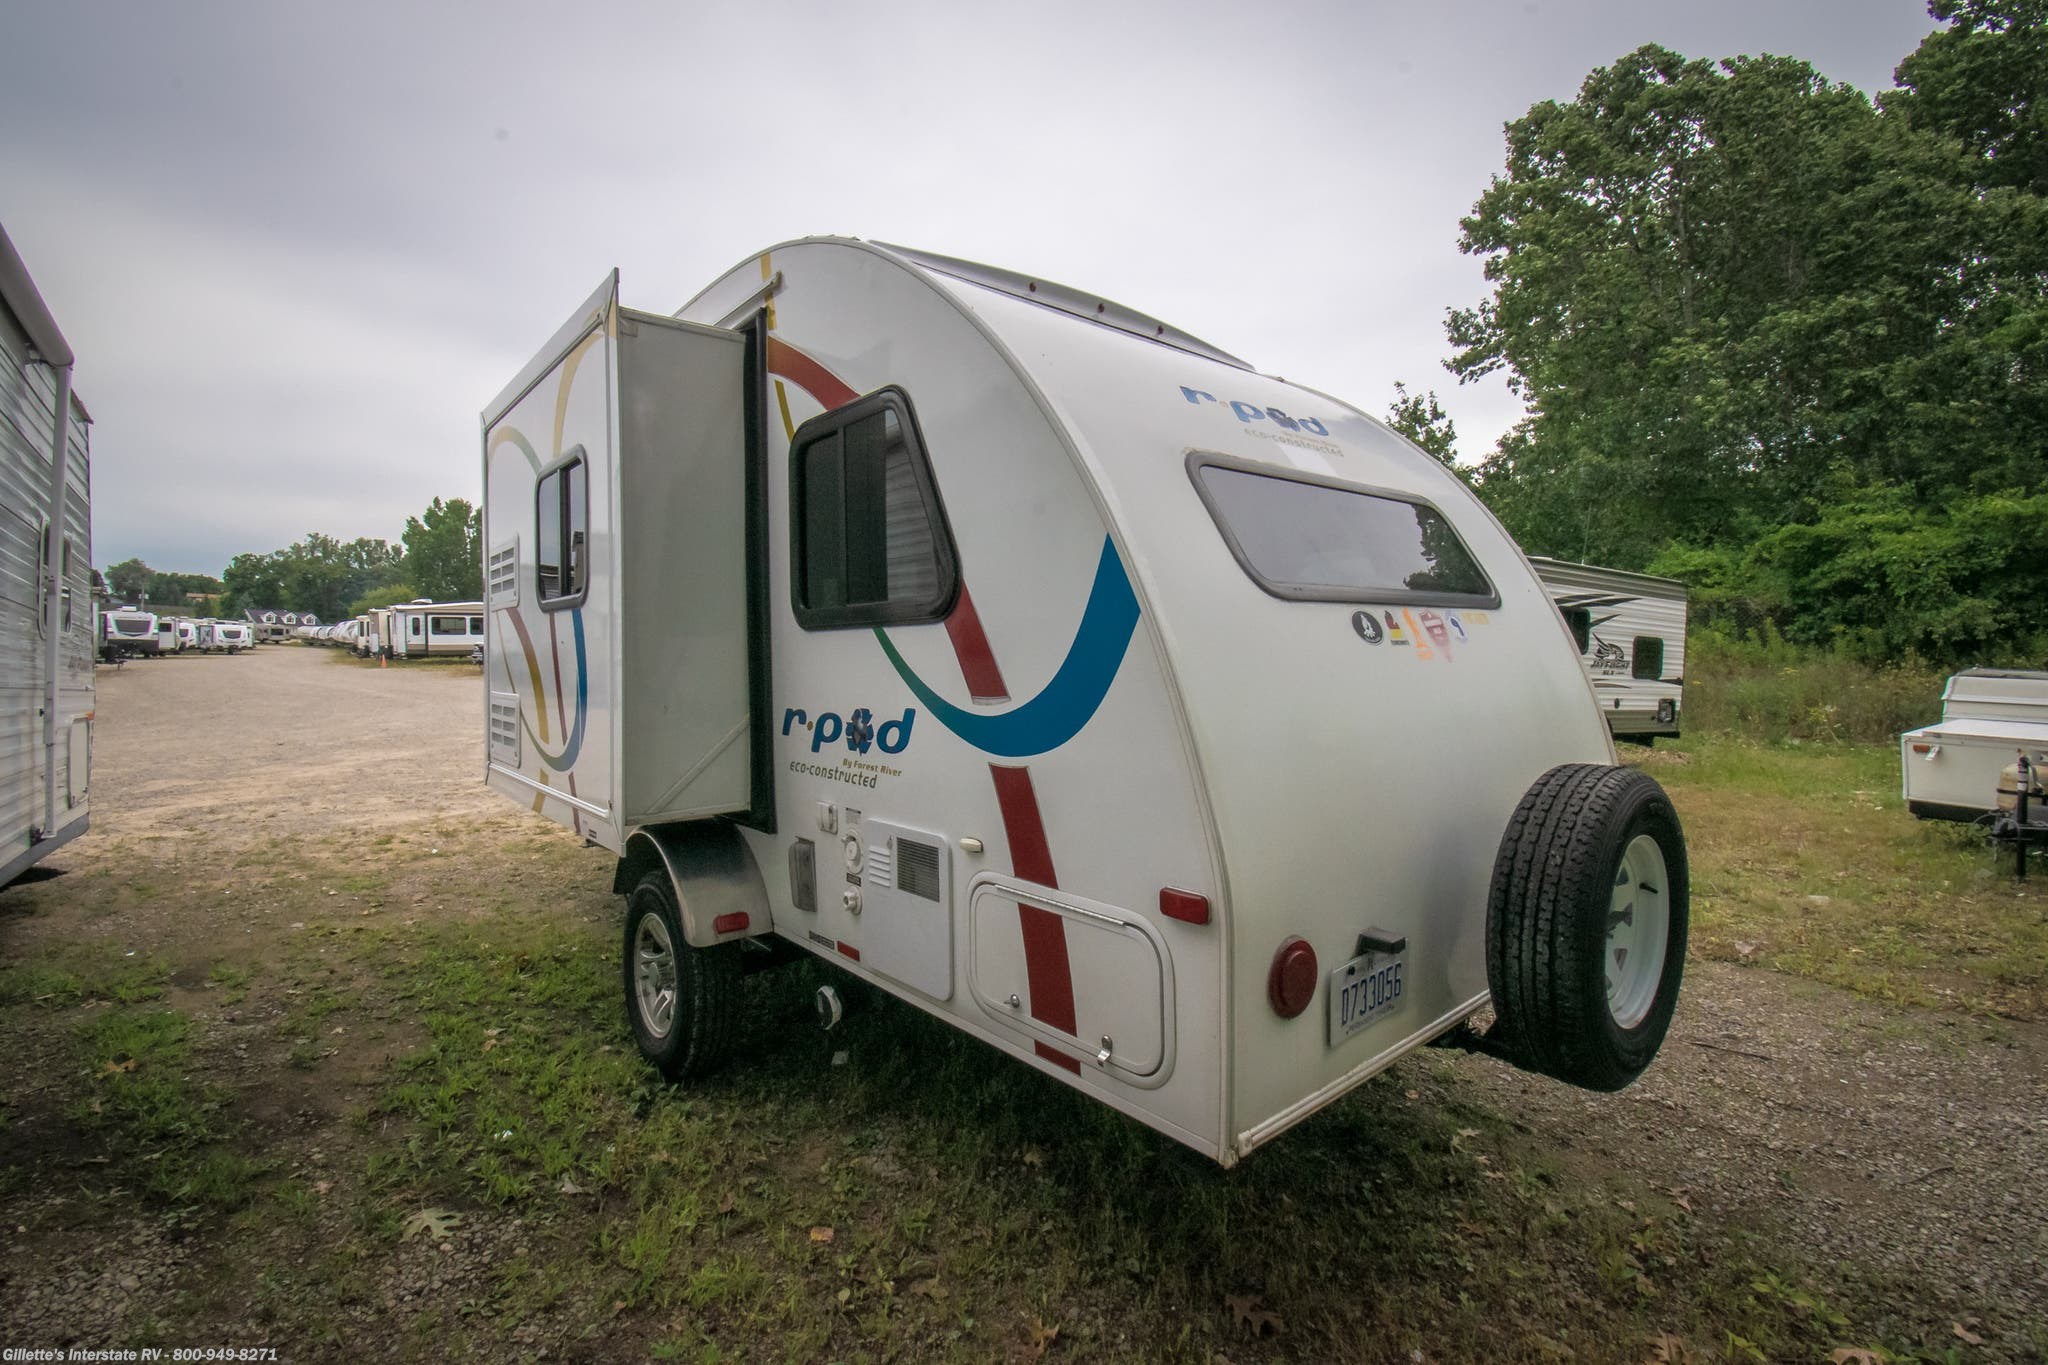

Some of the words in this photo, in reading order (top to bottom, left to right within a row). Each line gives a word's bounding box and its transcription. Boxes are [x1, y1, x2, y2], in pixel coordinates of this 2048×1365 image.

[842, 758, 852, 769] By
[853, 760, 879, 773] Forest
[880, 765, 902, 777] River
